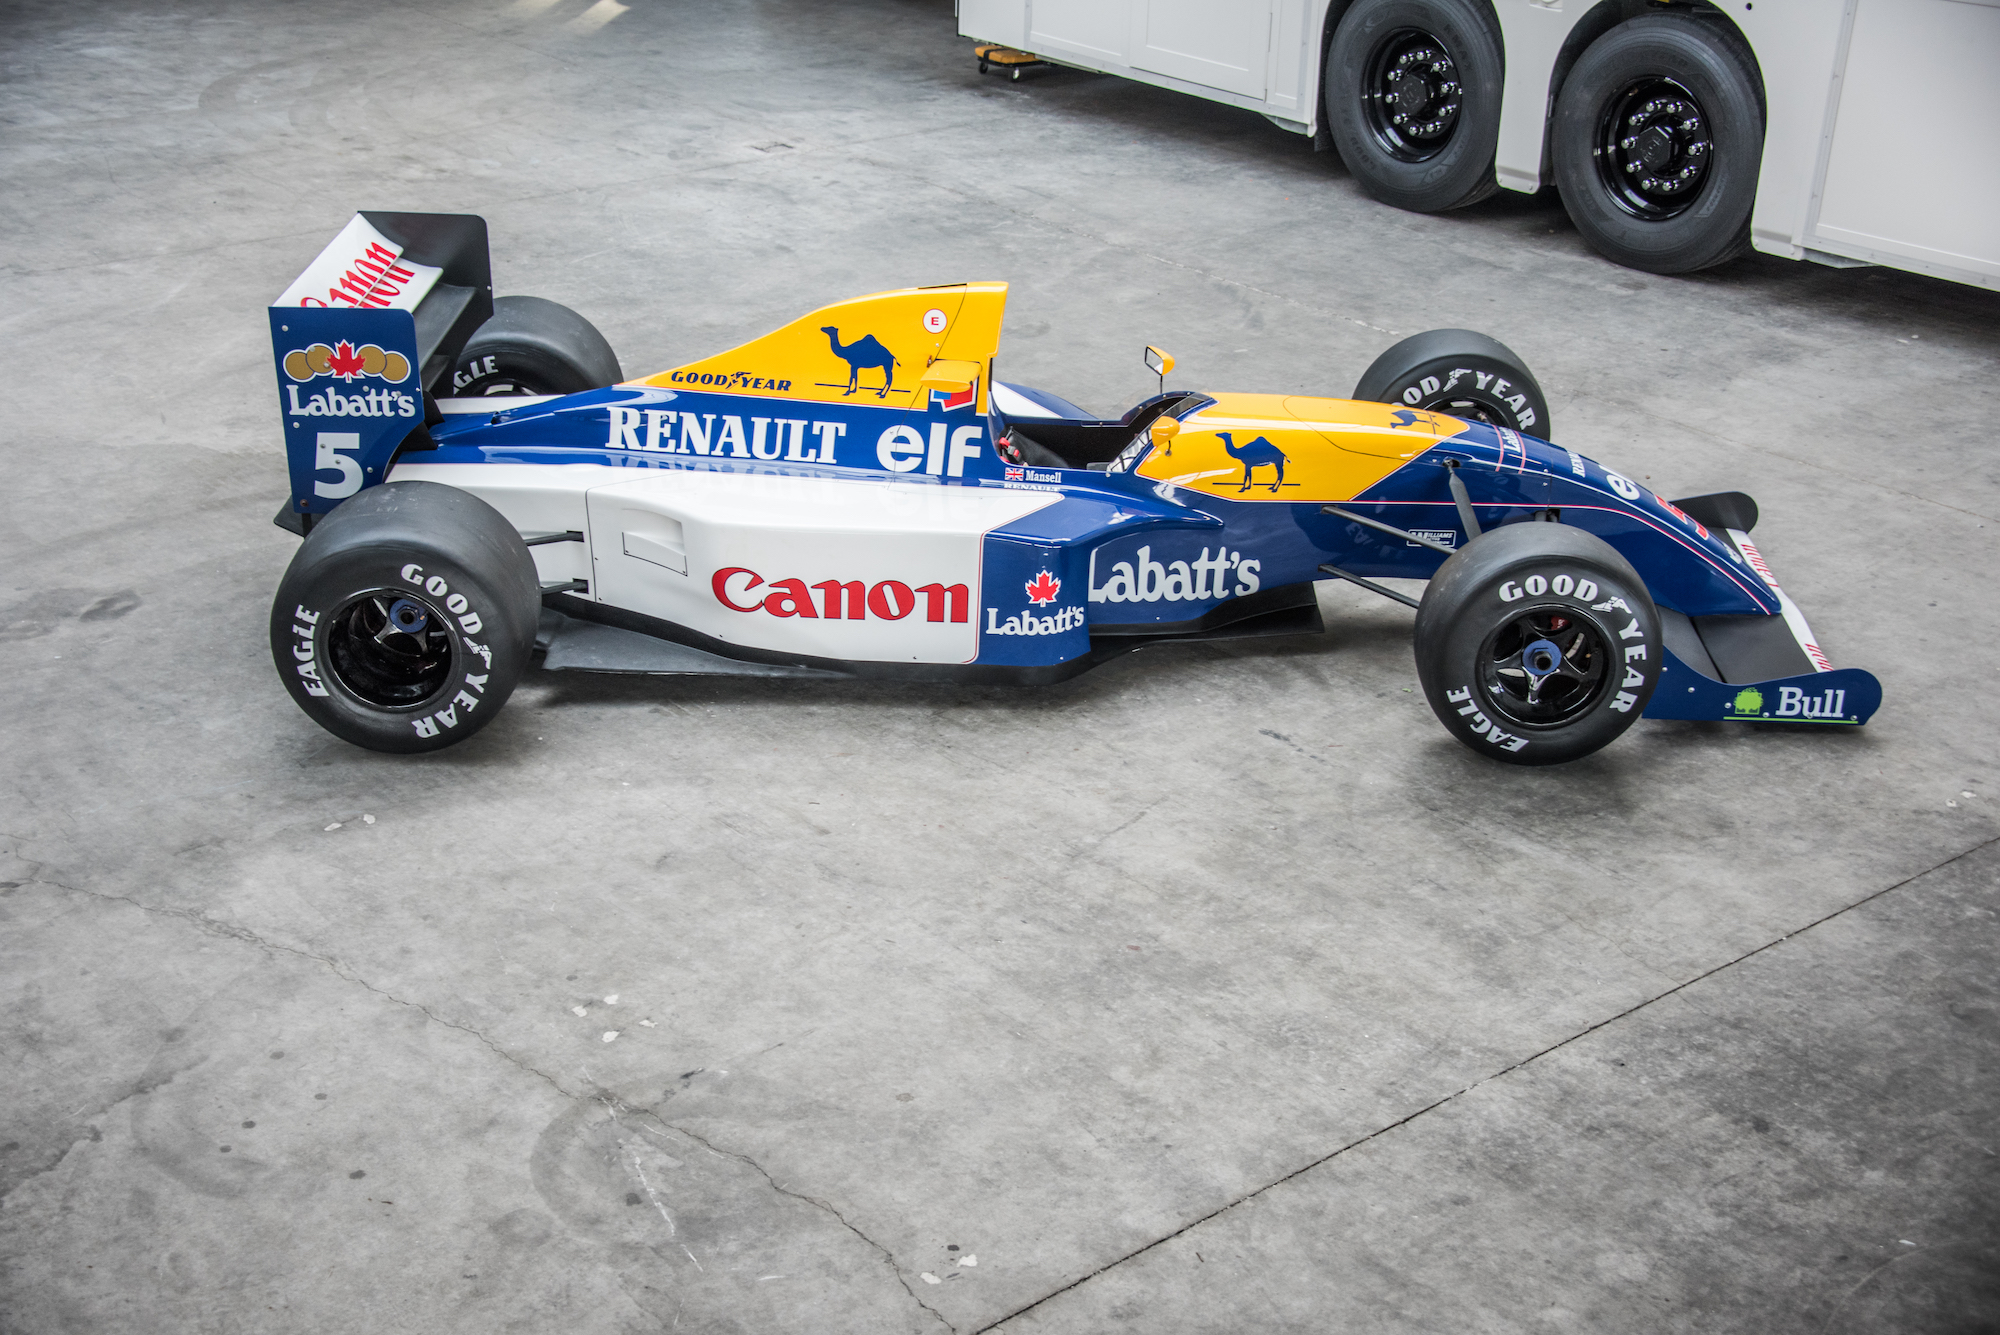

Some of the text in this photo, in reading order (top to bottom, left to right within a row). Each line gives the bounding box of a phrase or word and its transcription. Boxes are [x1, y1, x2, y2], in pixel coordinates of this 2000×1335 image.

[931, 316, 939, 326] E
[286, 384, 415, 417] Labatt's
[604, 406, 846, 464] RENAULT
[876, 422, 983, 477] elf
[313, 432, 364, 499] 5
[1003, 483, 1061, 492] RENAULT
[1025, 470, 1061, 483] Mansell
[711, 567, 969, 623] Canon
[1088, 545, 1261, 603] Labatt's
[986, 605, 1084, 635] Labatt's
[292, 604, 330, 697] EAGLE
[1446, 684, 1529, 753] EAGLE
[1775, 686, 1845, 718] Bull
